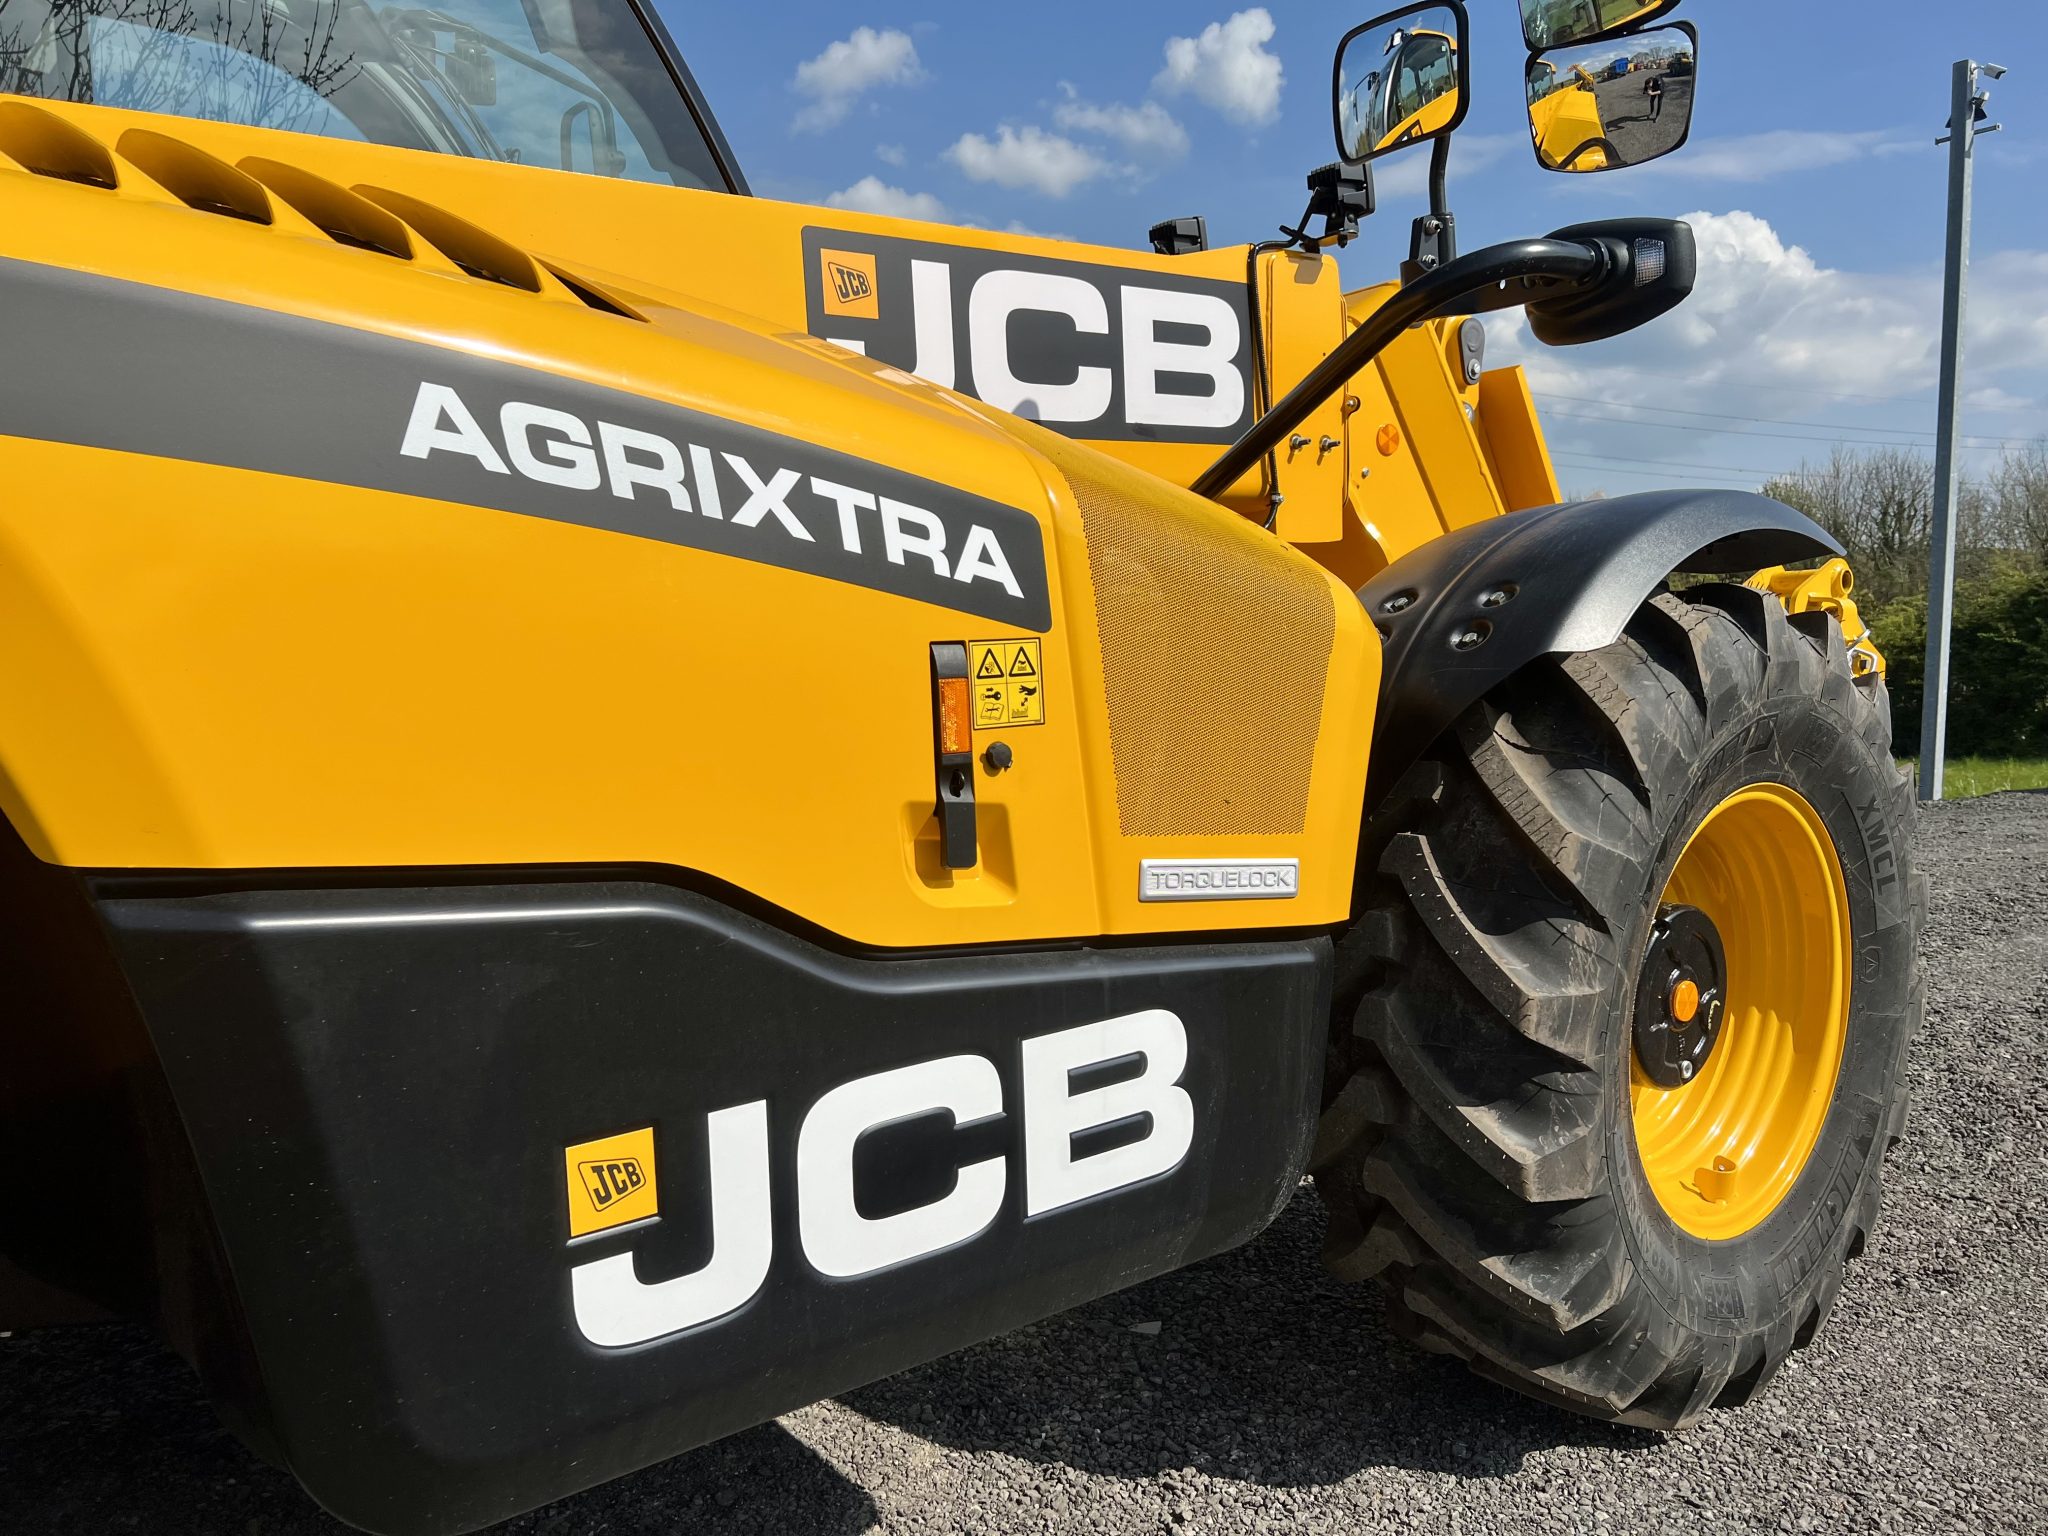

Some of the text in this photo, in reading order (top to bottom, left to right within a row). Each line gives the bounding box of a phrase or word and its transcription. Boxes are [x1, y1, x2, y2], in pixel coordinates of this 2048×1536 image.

[836, 267, 868, 299] JCB
[826, 259, 1245, 428] JCB
[400, 381, 1025, 599] AGRIXTRA
[1151, 868, 1290, 889] TORQUELOCK
[1857, 792, 1896, 897] XMCL
[571, 1008, 1195, 1347] JCB
[590, 1162, 641, 1205] JCB
